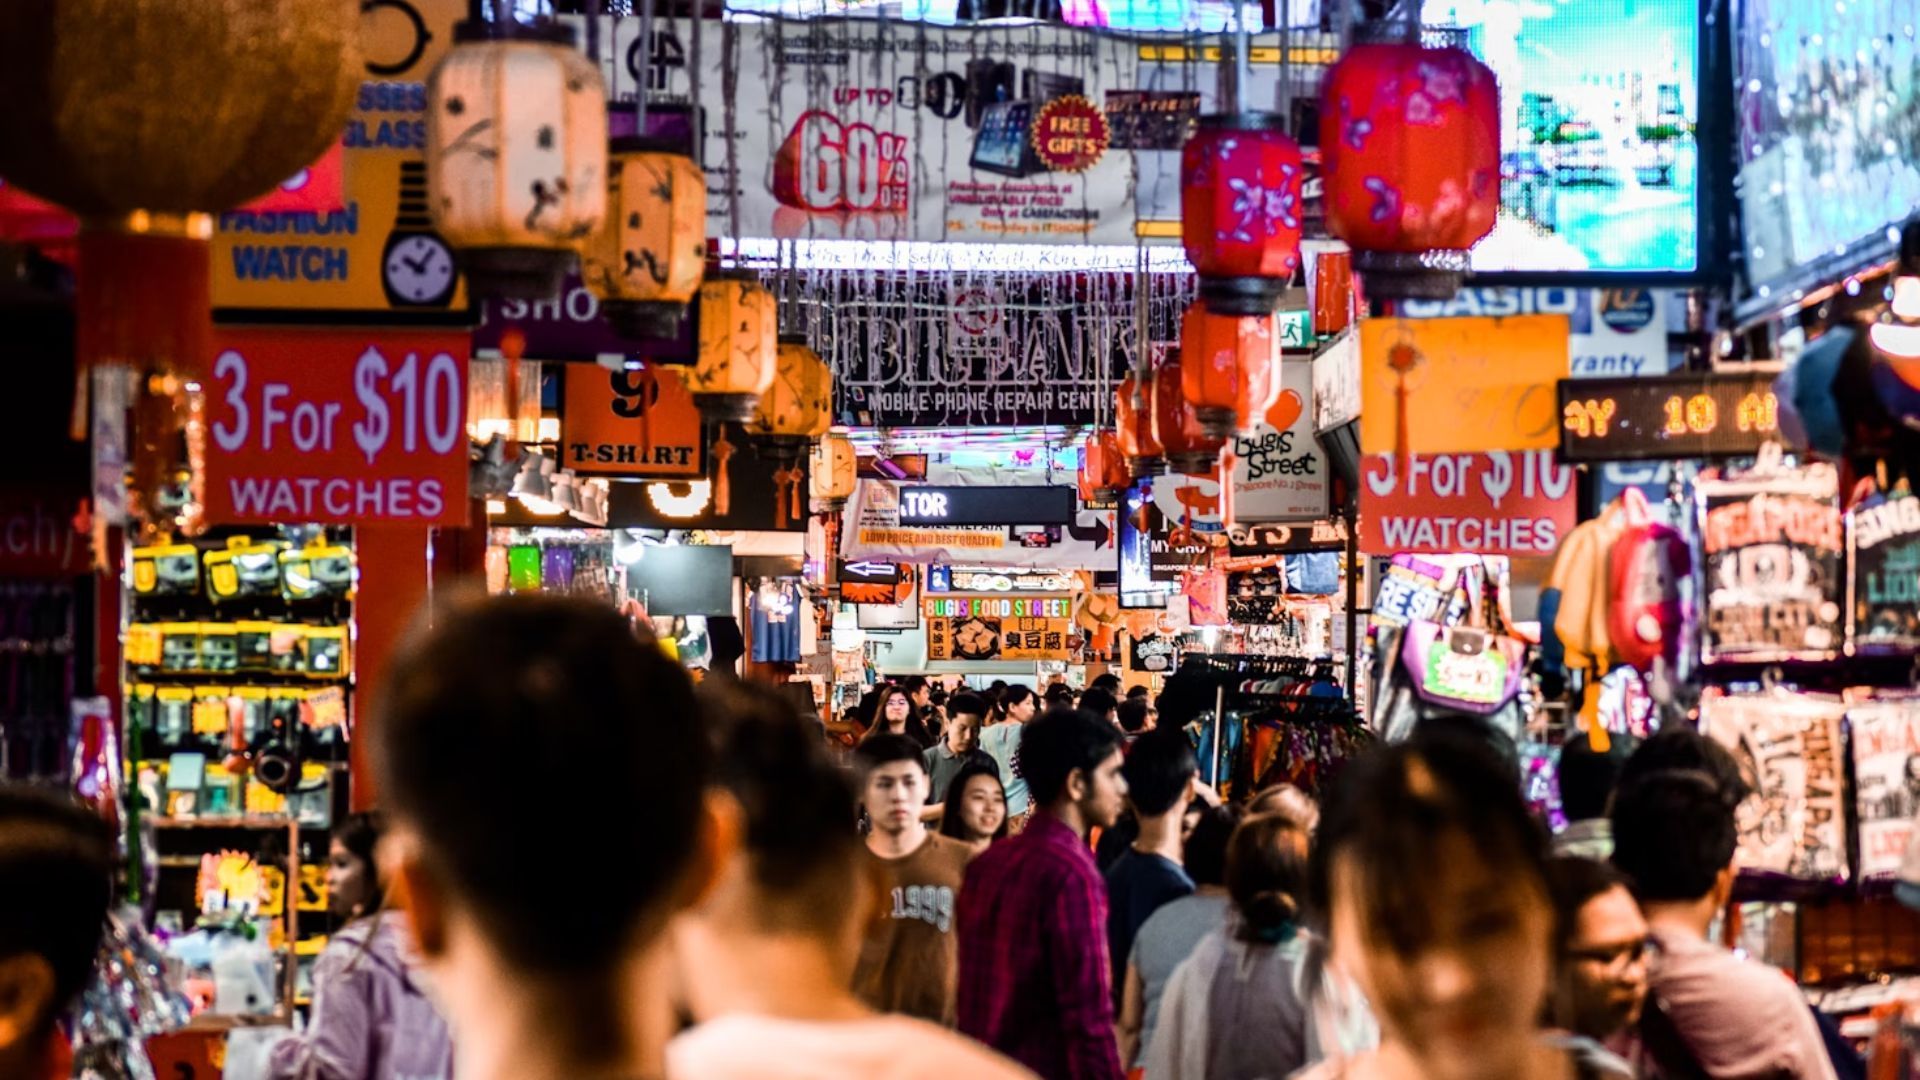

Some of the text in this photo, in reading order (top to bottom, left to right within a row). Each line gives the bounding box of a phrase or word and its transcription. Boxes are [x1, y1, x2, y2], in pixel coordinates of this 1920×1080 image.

[834, 89, 894, 105] UP TO
[1050, 117, 1091, 133] FREE
[1047, 138, 1097, 154] GIFTS
[232, 246, 348, 280] WATCH
[1403, 287, 1577, 316] CASIO
[212, 346, 461, 464] 3 For $10
[868, 391, 929, 411] MOBILE
[934, 391, 987, 411] PHONE
[993, 391, 1053, 410] REPAIR
[1664, 394, 1717, 434] 10
[1235, 431, 1294, 457] Bugis
[1247, 450, 1317, 481] Street
[1408, 454, 1472, 496] For
[230, 478, 444, 517] WATCHES
[865, 531, 997, 547] LOW PRICE AND BEST QUALITY
[1151, 540, 1170, 553] MY
[1381, 517, 1556, 551] WATCHES
[925, 599, 1069, 617] BUGIS FOOD STREET
[891, 885, 954, 933] 1999
